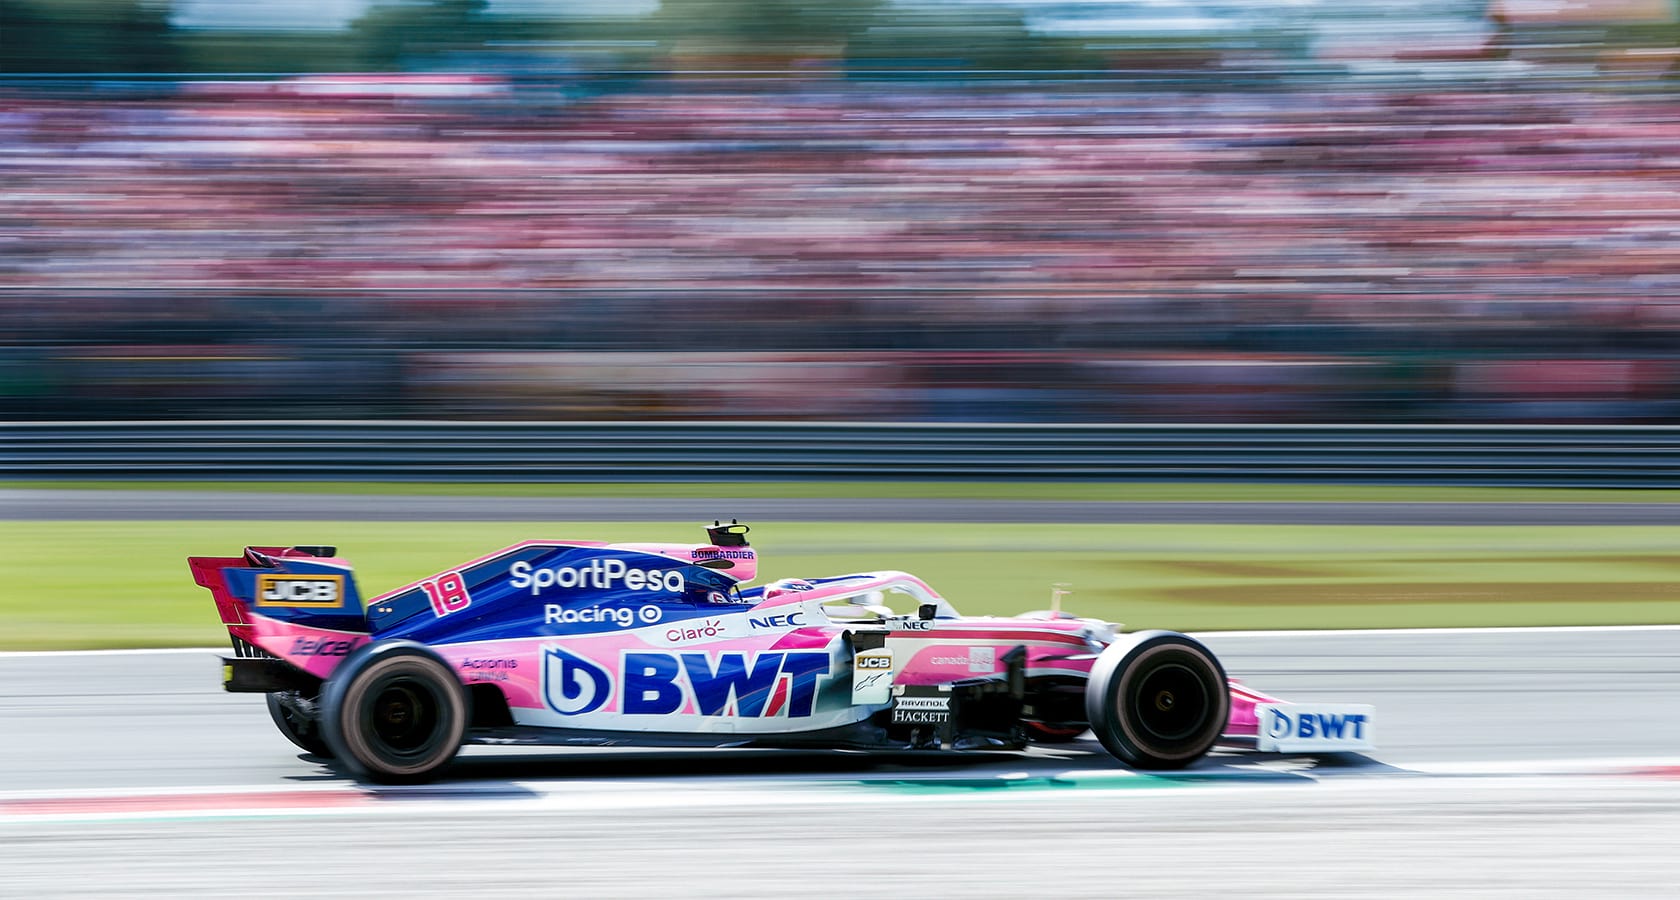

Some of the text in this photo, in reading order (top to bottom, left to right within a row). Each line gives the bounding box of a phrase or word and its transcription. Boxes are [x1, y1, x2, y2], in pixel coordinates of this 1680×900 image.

[691, 550, 754, 560] BOMBARDIER
[509, 559, 684, 595] SportPesa
[263, 580, 337, 602] JCB
[421, 571, 471, 617] 18
[544, 603, 633, 627] Racing
[749, 612, 807, 629] NEC
[666, 625, 718, 643] Claro
[903, 621, 929, 630] NEC
[290, 636, 360, 656] telcel
[461, 658, 518, 669] Acronis
[858, 657, 890, 668] JCB
[622, 653, 829, 718] BWT
[894, 710, 950, 723] HACKETT
[1298, 714, 1368, 740] BWT
